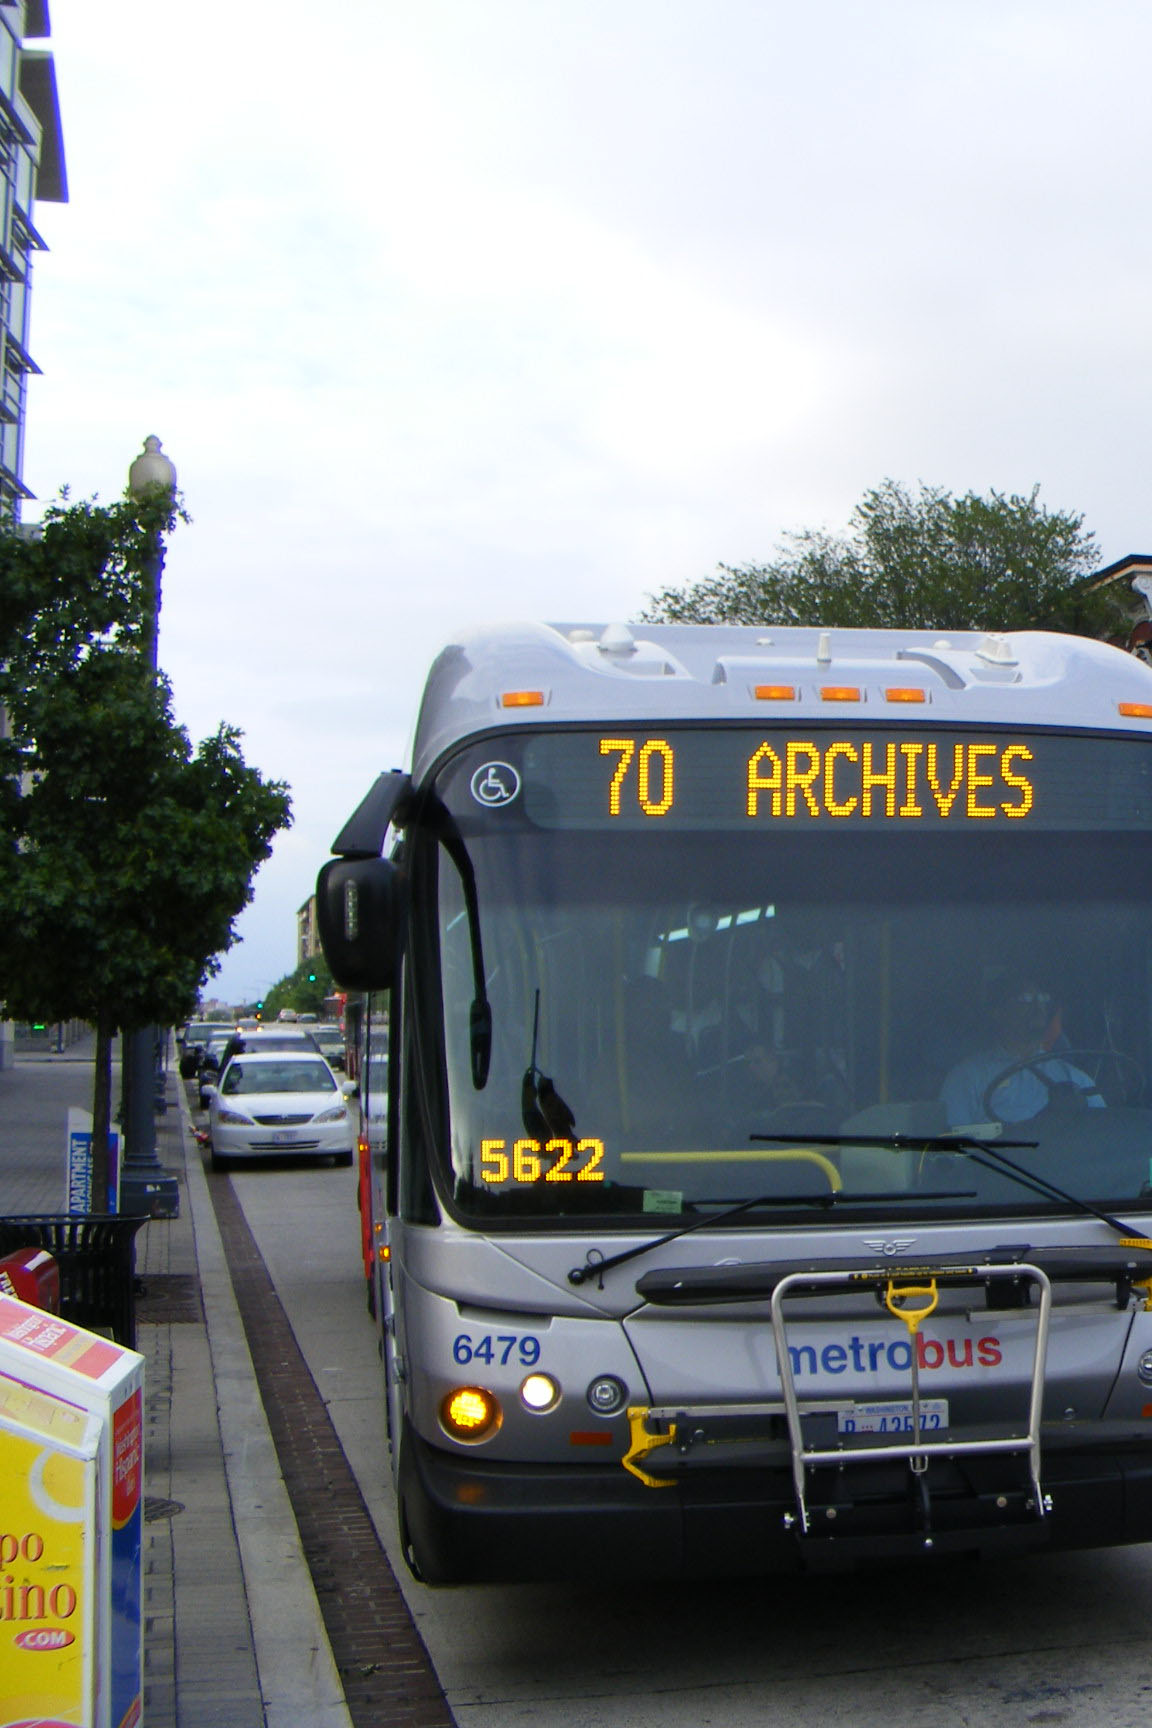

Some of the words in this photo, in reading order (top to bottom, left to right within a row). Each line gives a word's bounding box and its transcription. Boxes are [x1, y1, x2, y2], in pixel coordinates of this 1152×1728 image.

[599, 738, 673, 815] 70
[747, 740, 1033, 817] ARCHIVES
[70, 1138, 88, 1214] APARTMENT
[480, 1138, 605, 1182] 5622
[452, 1333, 542, 1366] 6479
[776, 1331, 1003, 1376] metrobus
